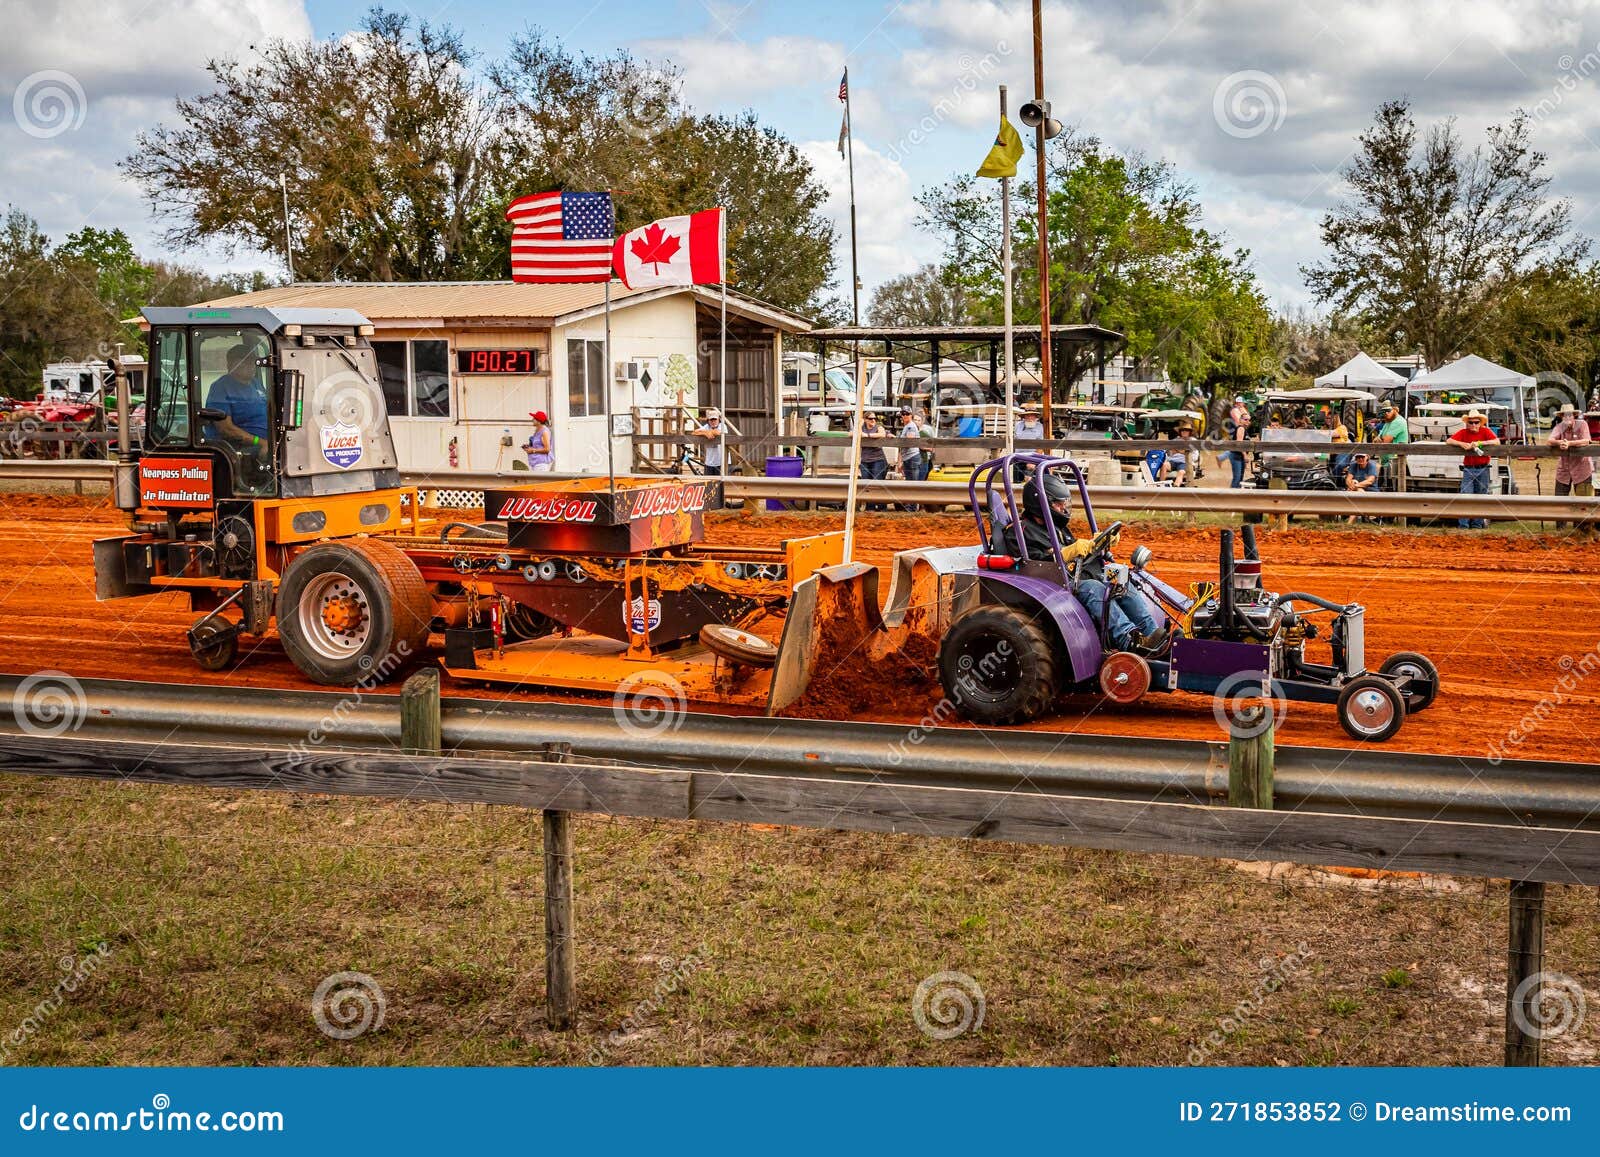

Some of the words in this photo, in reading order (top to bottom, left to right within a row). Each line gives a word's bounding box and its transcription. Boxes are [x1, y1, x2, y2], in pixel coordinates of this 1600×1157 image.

[470, 351, 530, 371] 190.27
[327, 436, 358, 448] LUCAS
[142, 467, 180, 479] Nearpass
[181, 467, 208, 480] Pulling
[143, 490, 156, 500] Jr
[158, 490, 210, 501] Humilator
